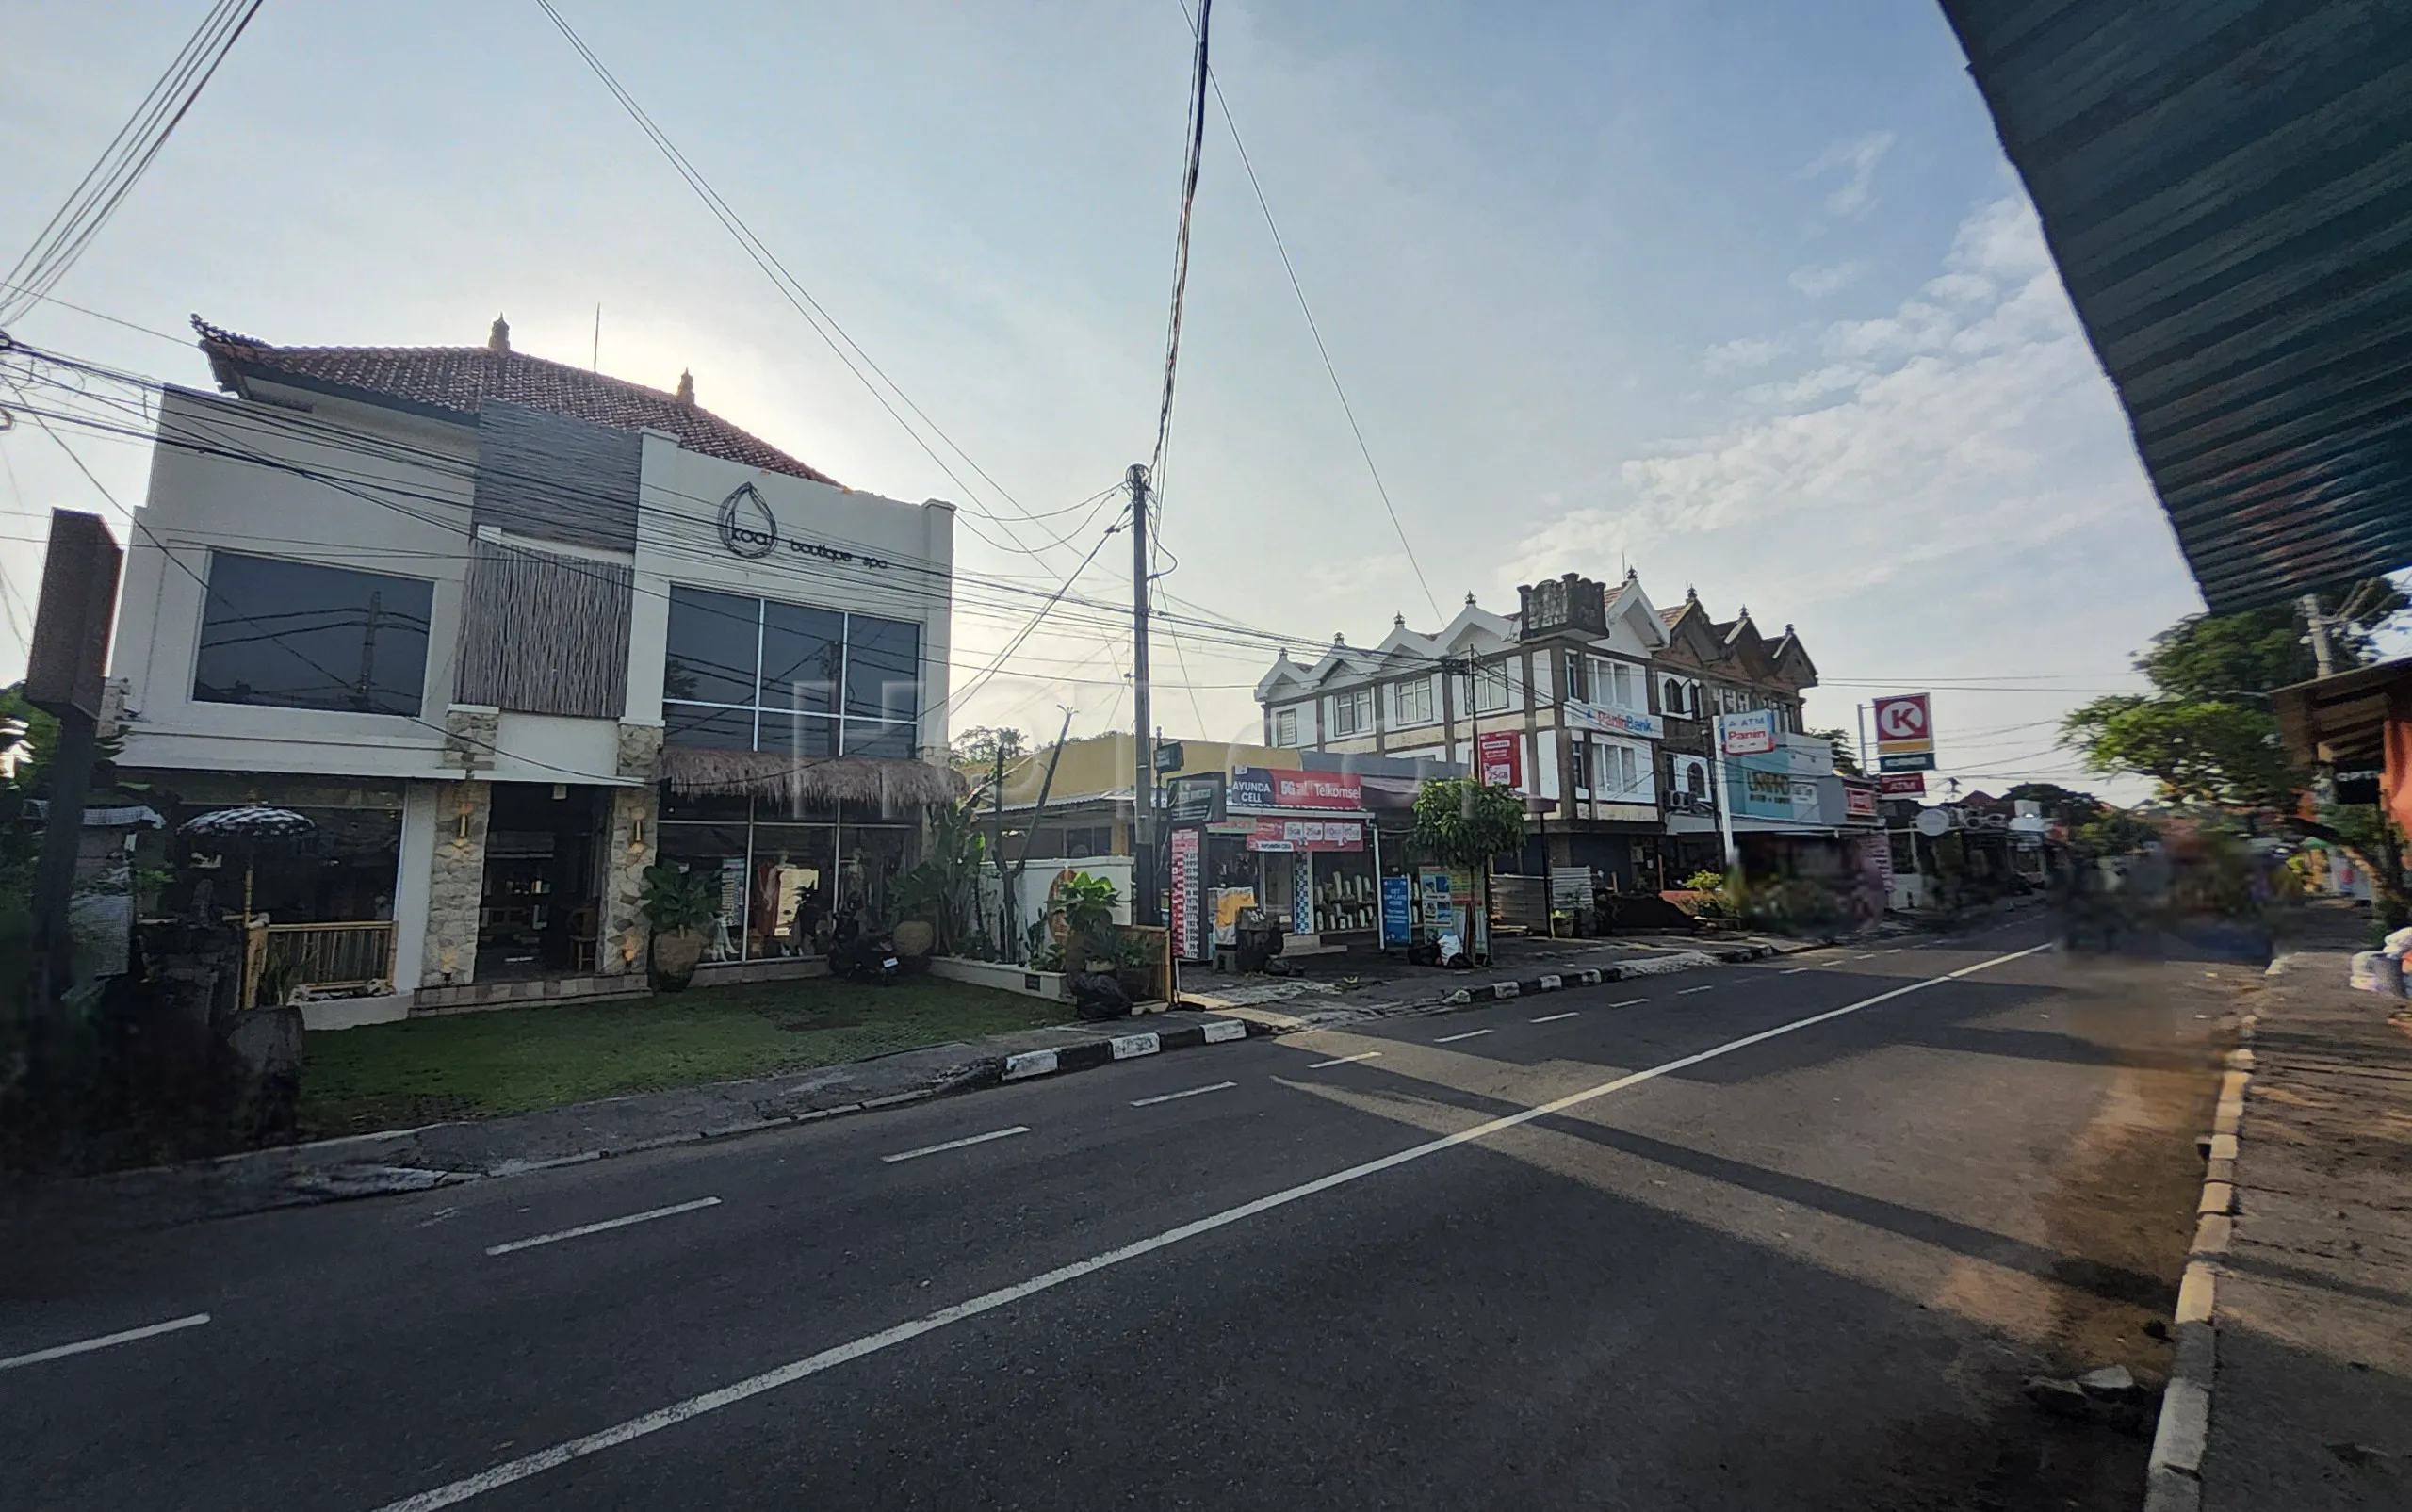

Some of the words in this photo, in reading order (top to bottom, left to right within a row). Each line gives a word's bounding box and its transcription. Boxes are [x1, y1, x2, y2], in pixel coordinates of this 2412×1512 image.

[862, 557, 888, 569] spa
[1740, 717, 1765, 726] ATM
[1890, 707, 1922, 730] K
[1727, 728, 1767, 740] Panin
[1487, 771, 1509, 781] 25GB
[1232, 780, 1271, 793] AYUNDA
[1313, 783, 1362, 800] Telkomsel
[1240, 791, 1263, 803] CELL
